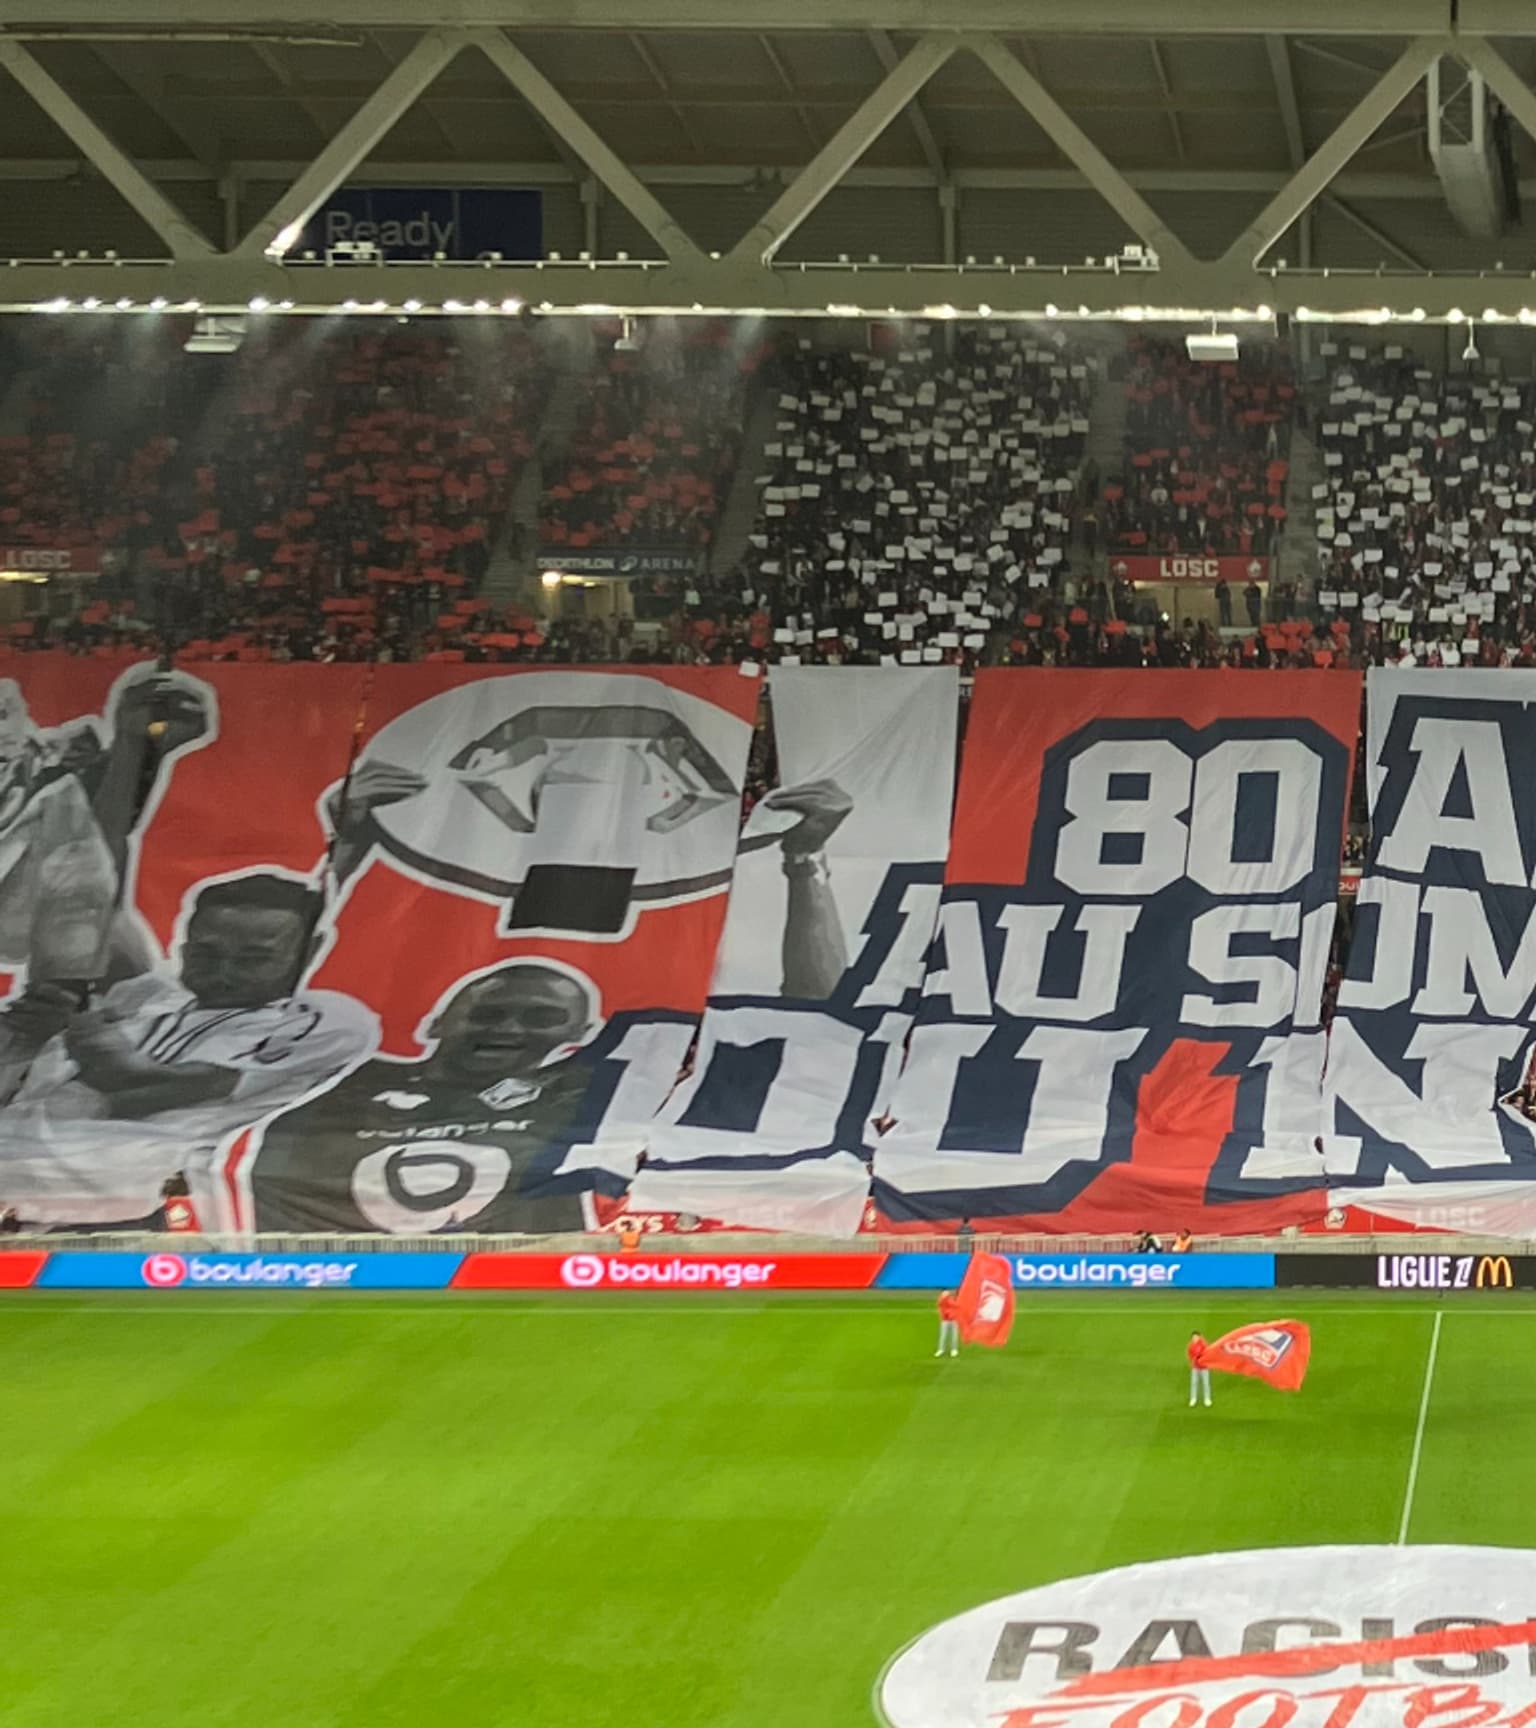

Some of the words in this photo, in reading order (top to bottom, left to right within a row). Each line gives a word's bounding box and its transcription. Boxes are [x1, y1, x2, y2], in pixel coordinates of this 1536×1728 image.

[326, 210, 455, 252] Ready
[1160, 559, 1219, 577] LOSC
[1054, 738, 1323, 896] 80
[854, 883, 1143, 1022] AU
[190, 1258, 358, 1286] boulanger
[609, 1258, 776, 1287] boulanger
[1017, 1260, 1181, 1285] boulanger
[1378, 1256, 1451, 1287] LIGUE
